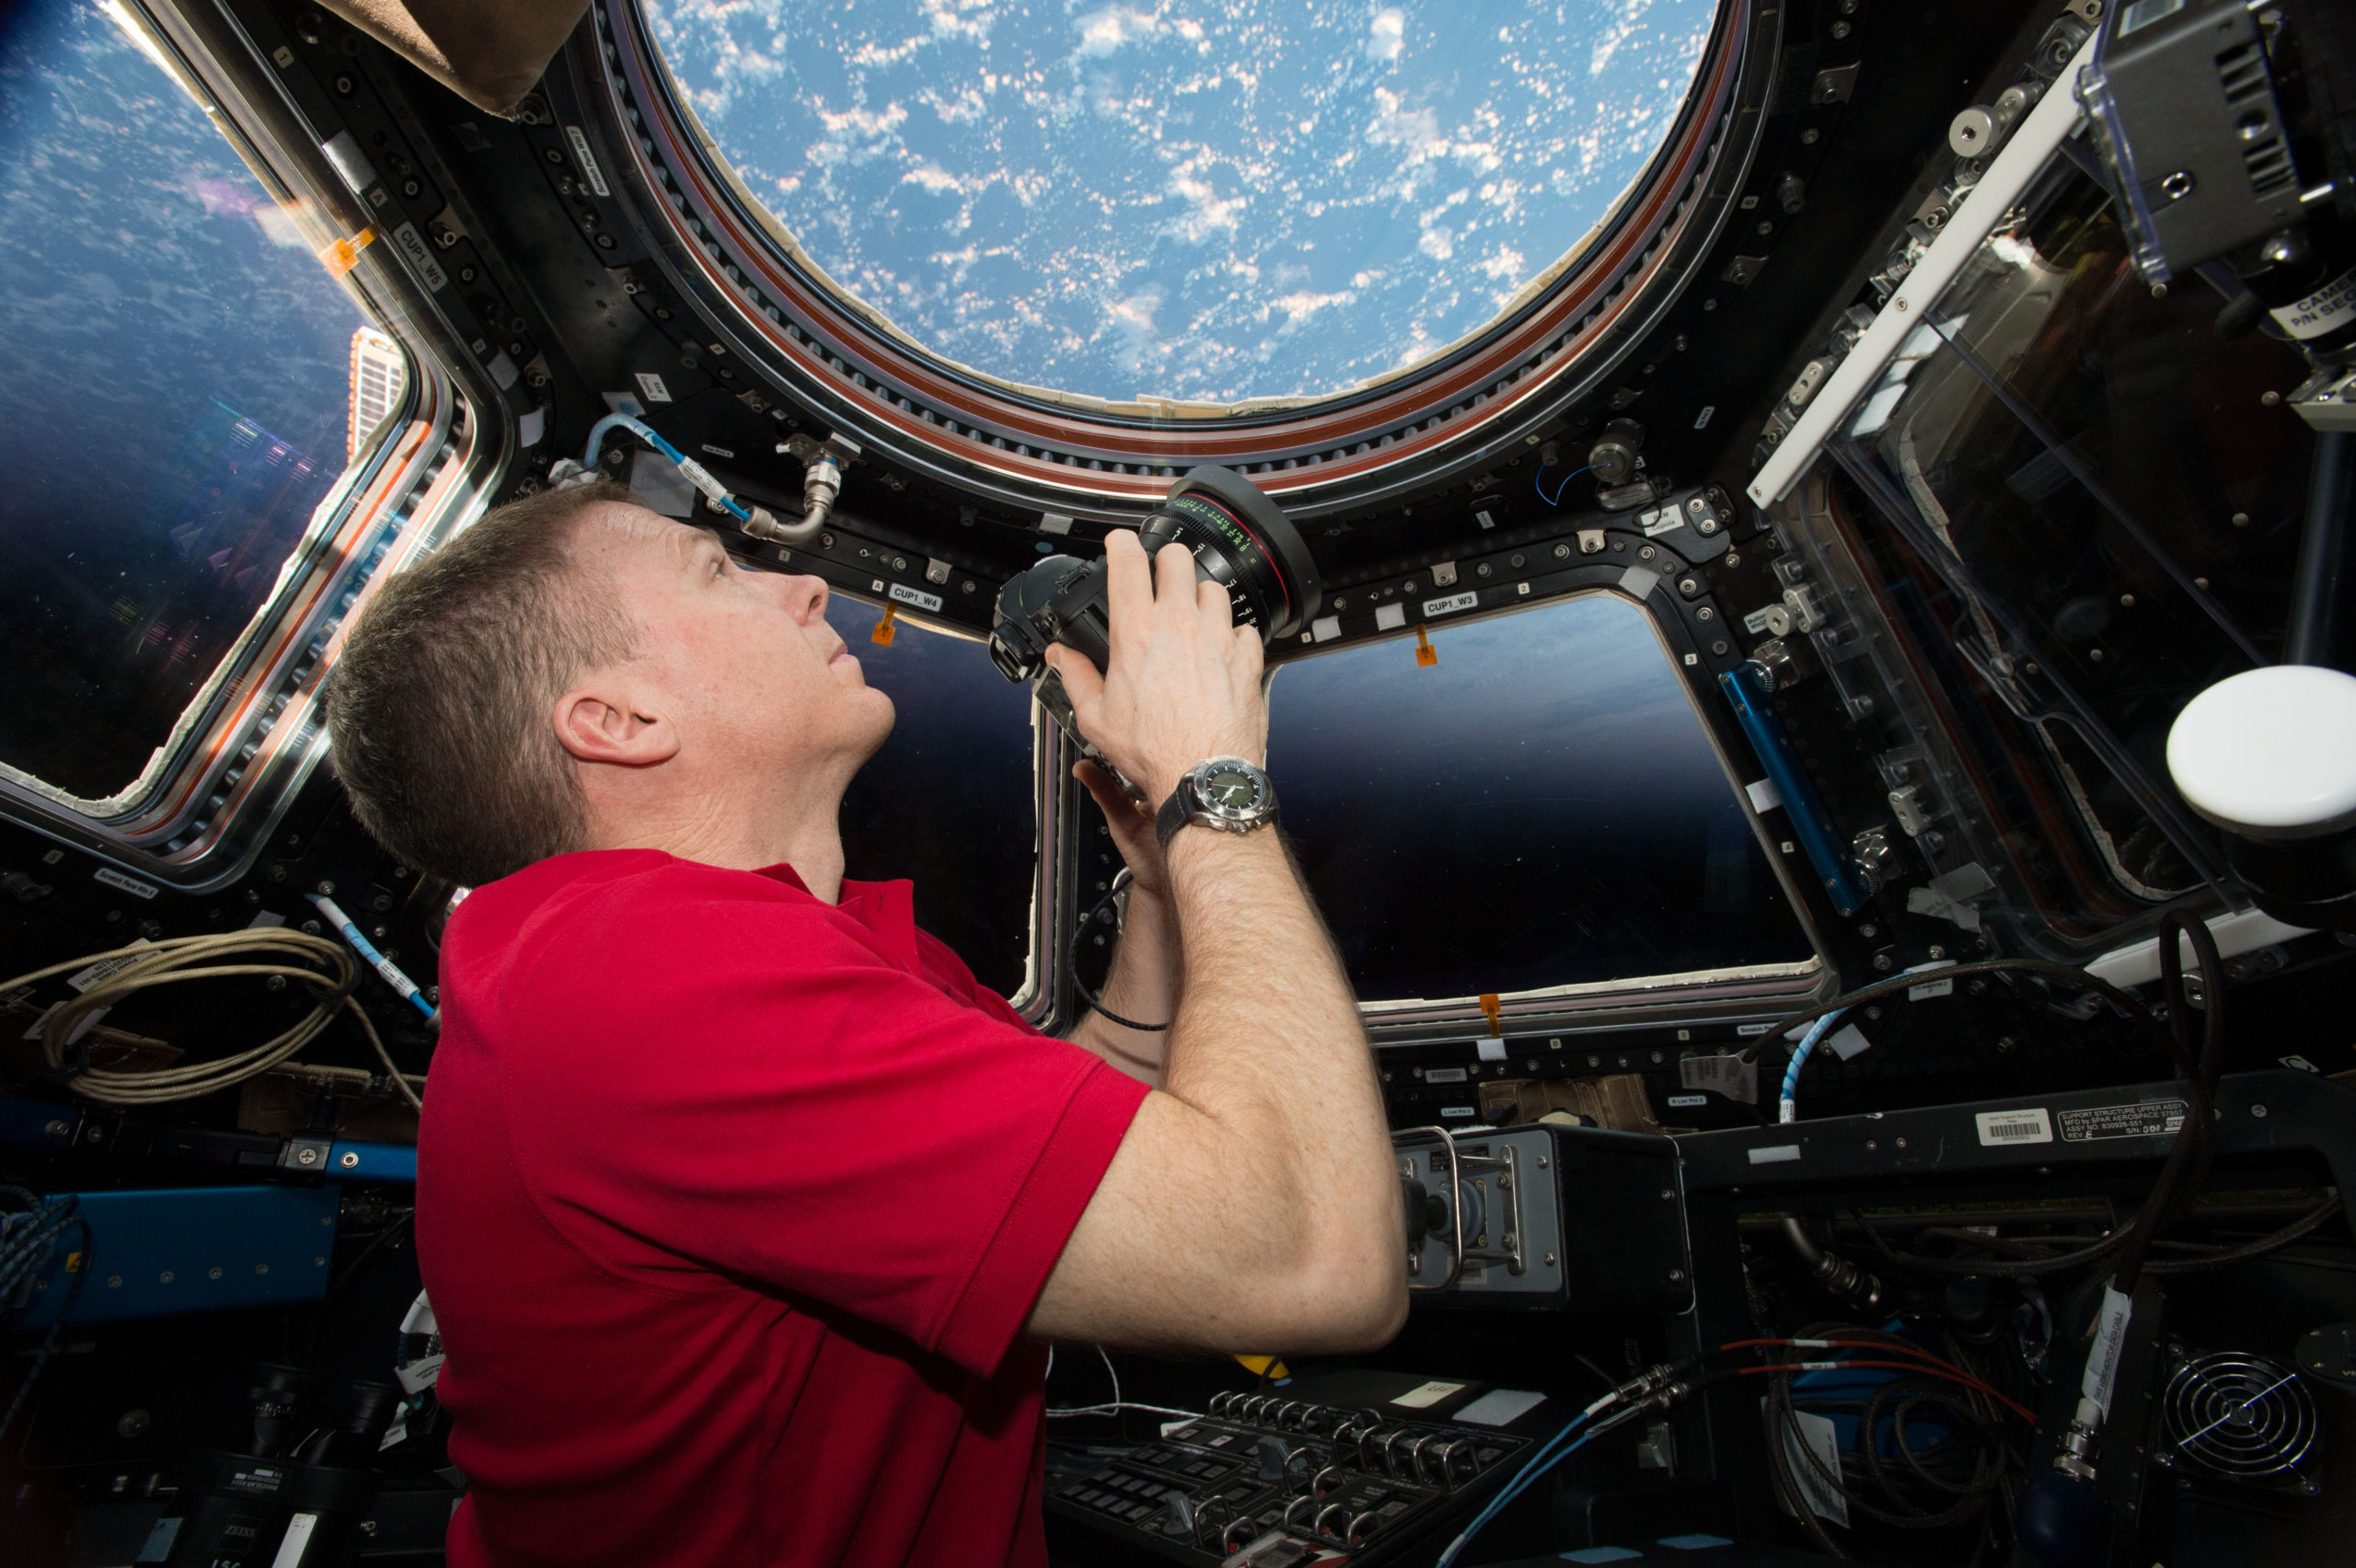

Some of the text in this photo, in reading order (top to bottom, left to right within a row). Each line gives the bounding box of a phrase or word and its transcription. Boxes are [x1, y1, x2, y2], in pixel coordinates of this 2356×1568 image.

[400, 229, 441, 284] CUP1_W5
[894, 587, 938, 607] CUP1_W4
[1427, 595, 1473, 613] CUP1_W3
[2061, 1102, 2182, 1120] SUPPORT STRUCTURE UPPER ASSY
[2112, 1111, 2160, 1122] AEROSPACE
[2066, 1124, 2085, 1133] ASSY
